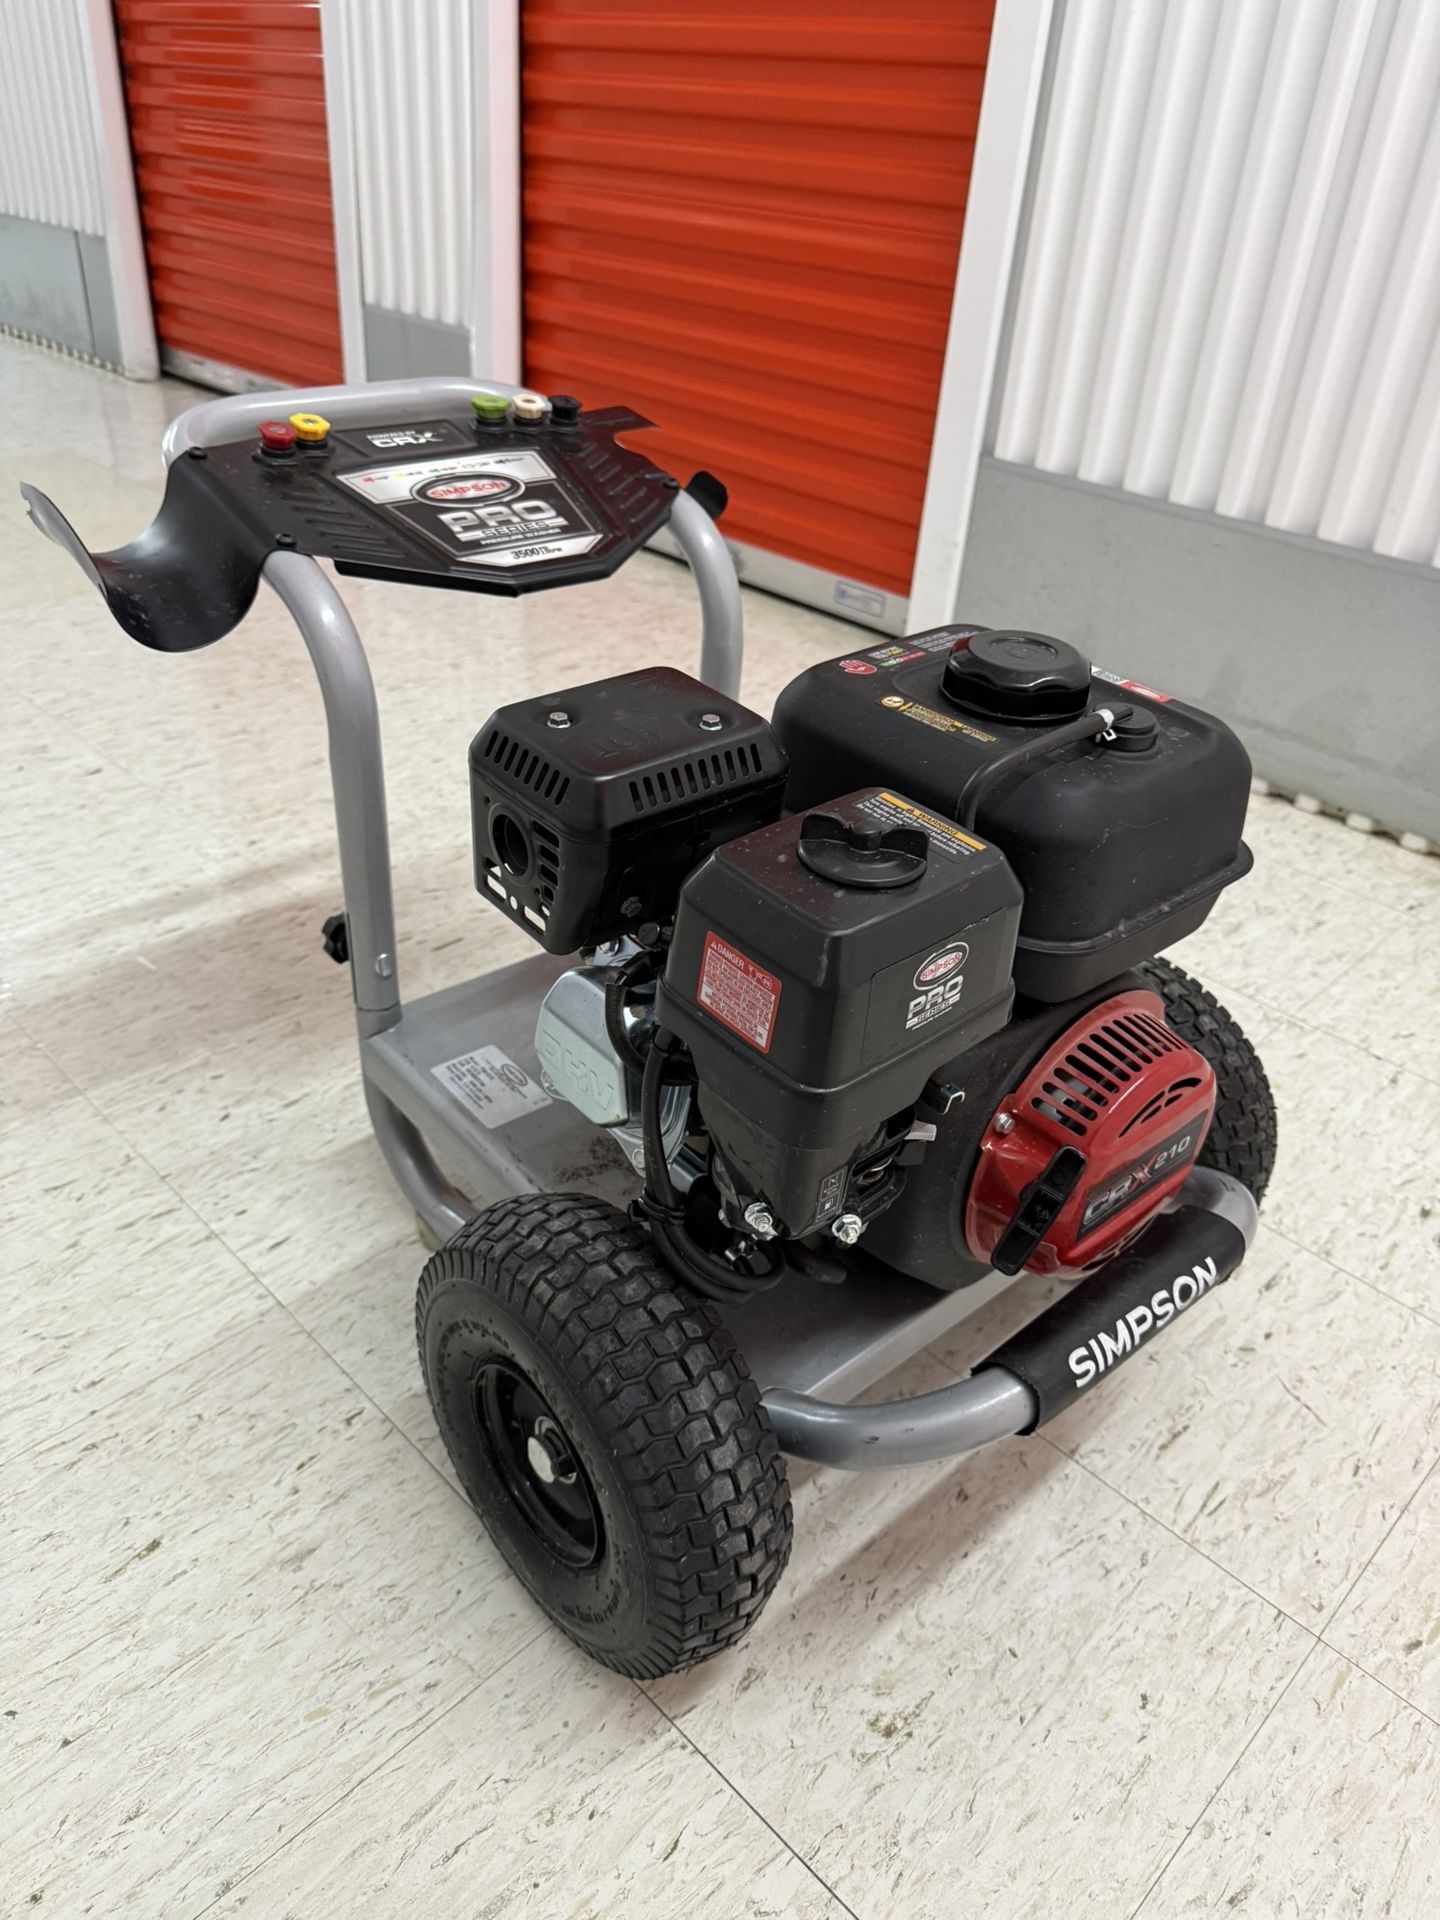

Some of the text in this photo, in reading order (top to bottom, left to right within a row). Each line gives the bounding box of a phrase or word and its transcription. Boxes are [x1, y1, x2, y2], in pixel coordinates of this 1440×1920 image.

[370, 432, 443, 448] CRX
[430, 481, 506, 499] SIMPSON
[437, 500, 557, 533] PRO
[481, 520, 549, 538] SERIES
[511, 547, 541, 560] 3500
[919, 812, 958, 836] WARNING
[716, 942, 745, 971] DANGER
[921, 953, 962, 980] SIMPSON
[907, 975, 963, 1020] PRO
[1083, 1135, 1191, 1226] CRX 210
[1068, 1256, 1218, 1389] SIMPSON
